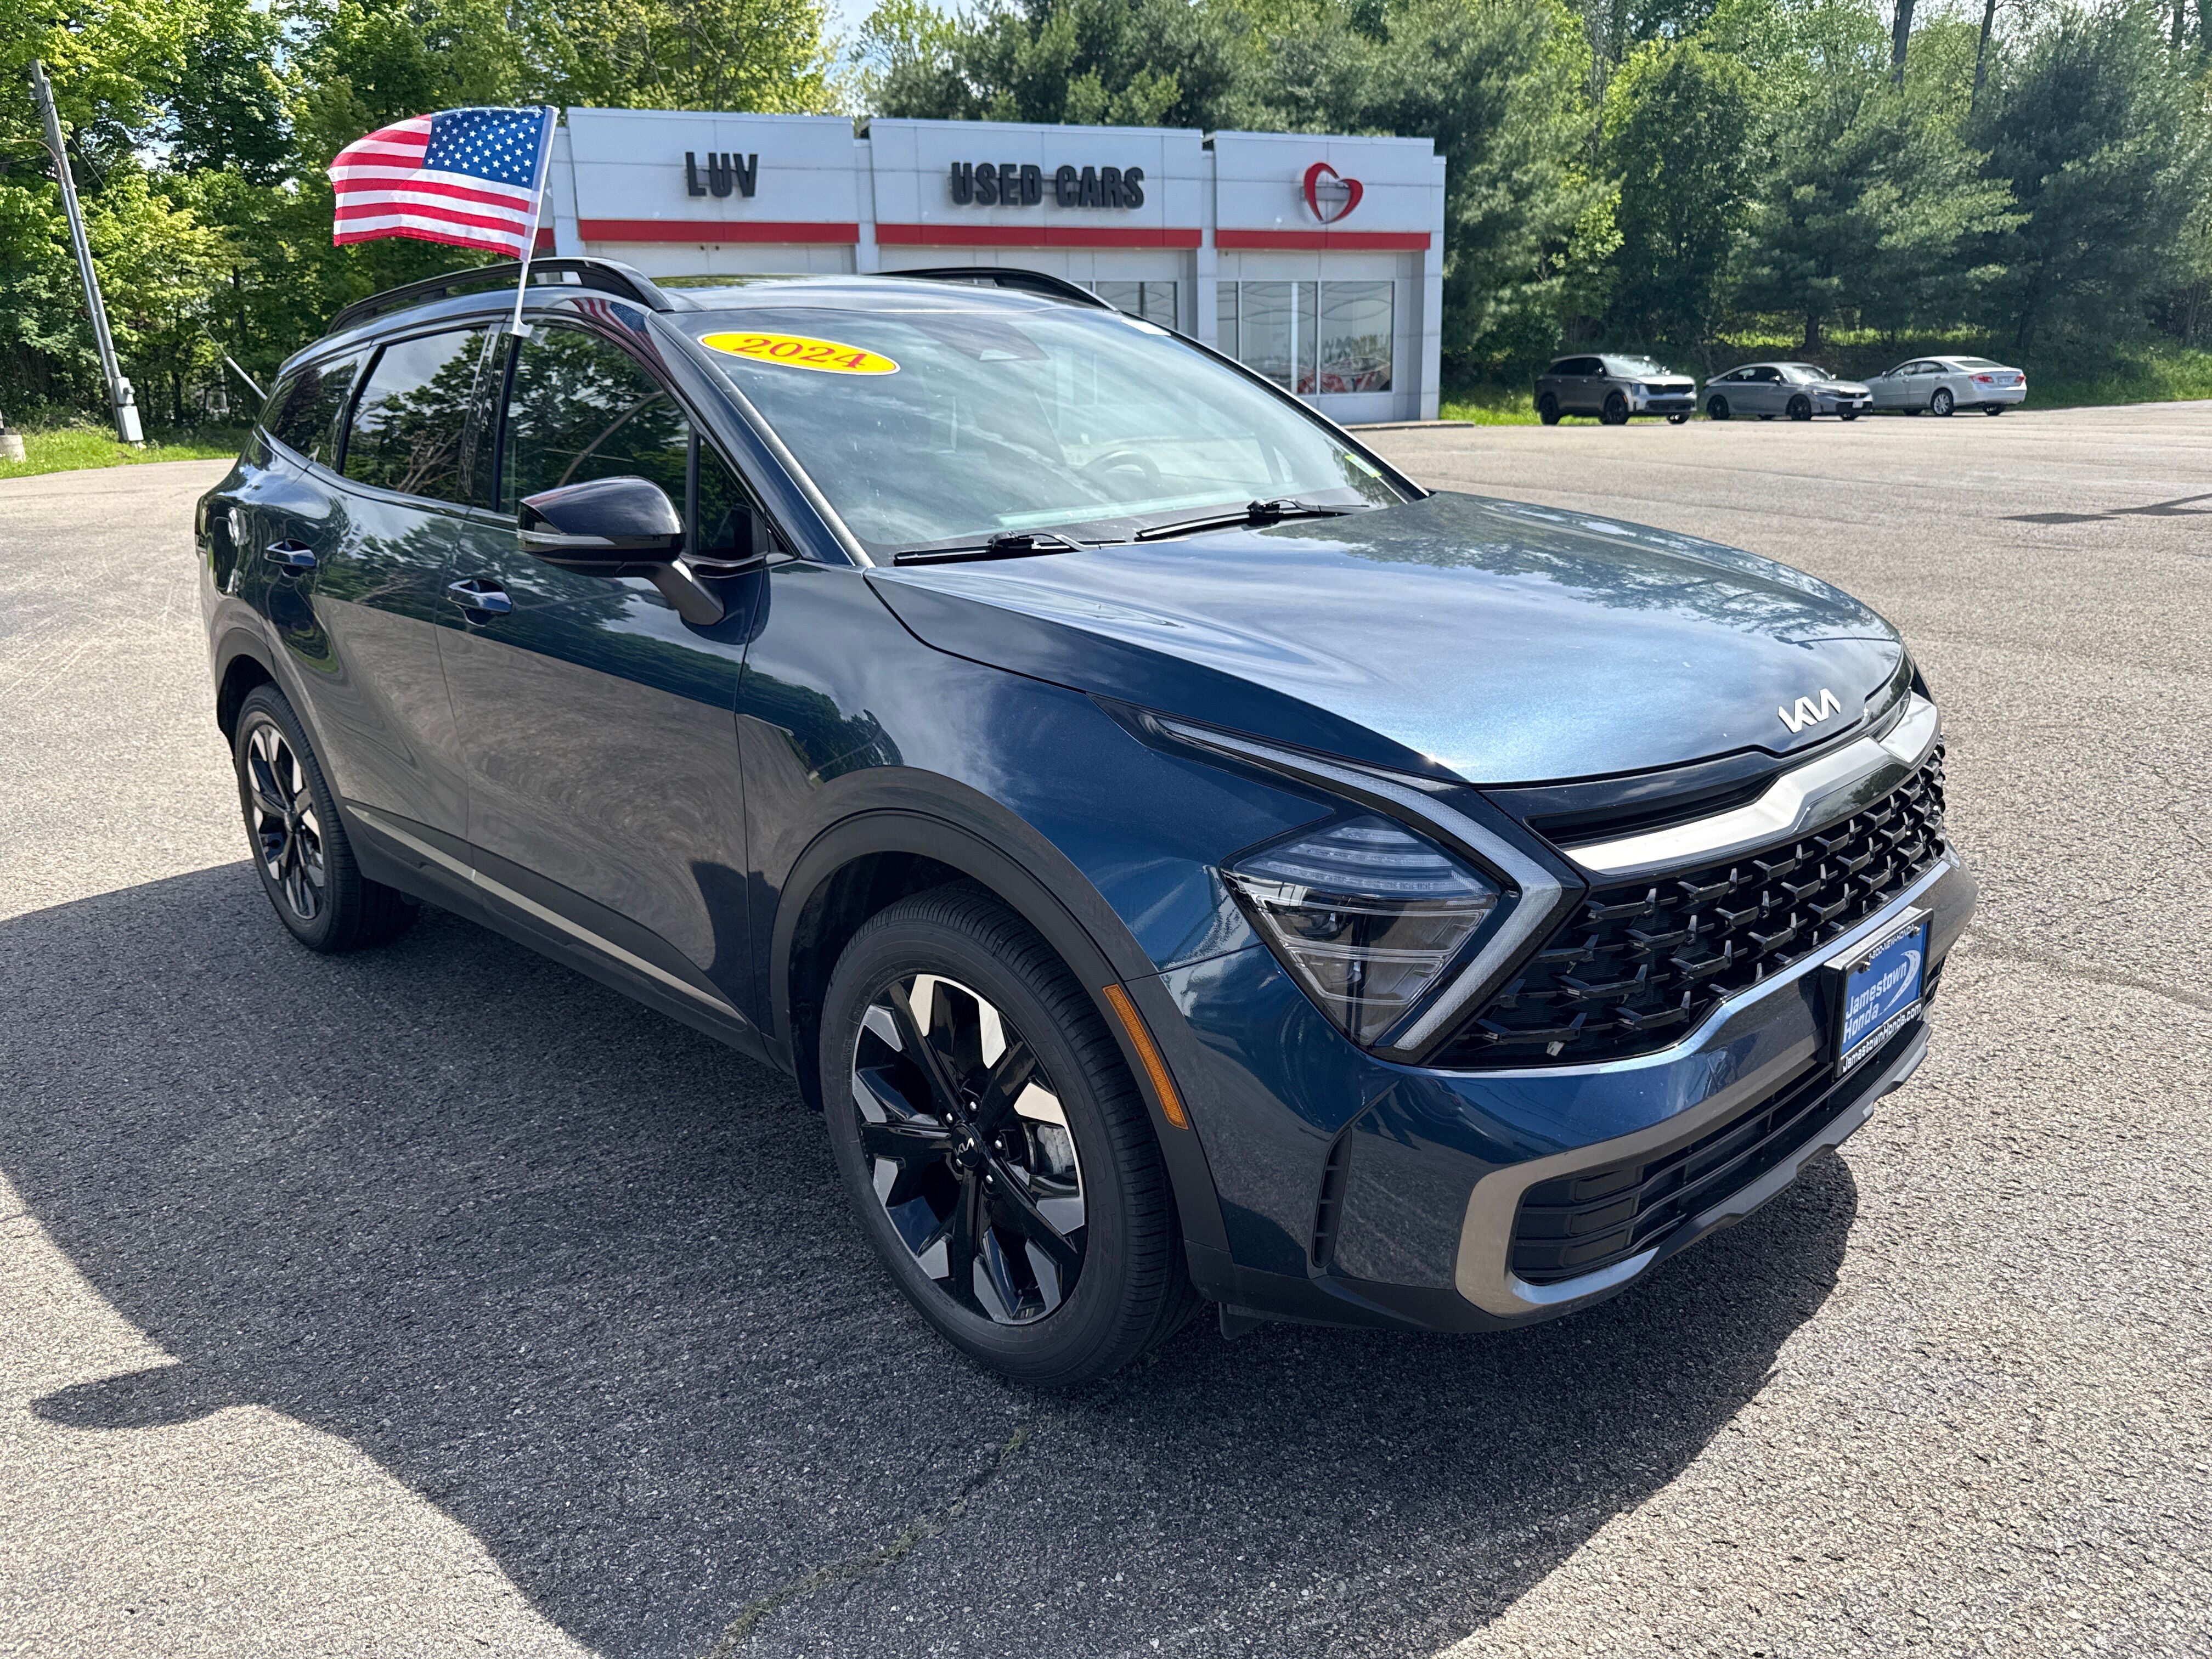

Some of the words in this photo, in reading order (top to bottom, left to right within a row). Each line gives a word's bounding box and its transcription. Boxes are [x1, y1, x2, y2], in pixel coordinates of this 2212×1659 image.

[685, 152, 758, 197] LUV
[951, 162, 1042, 206] USED
[1057, 166, 1144, 208] CARS
[733, 338, 868, 368] 2024
[1778, 688, 1841, 733] KIA
[1846, 961, 1907, 1019] Jamestown
[1843, 1002, 1879, 1043] Honda
[1843, 1003, 1921, 1073] JamestownHonda.com
[955, 1137, 974, 1155] KIA
